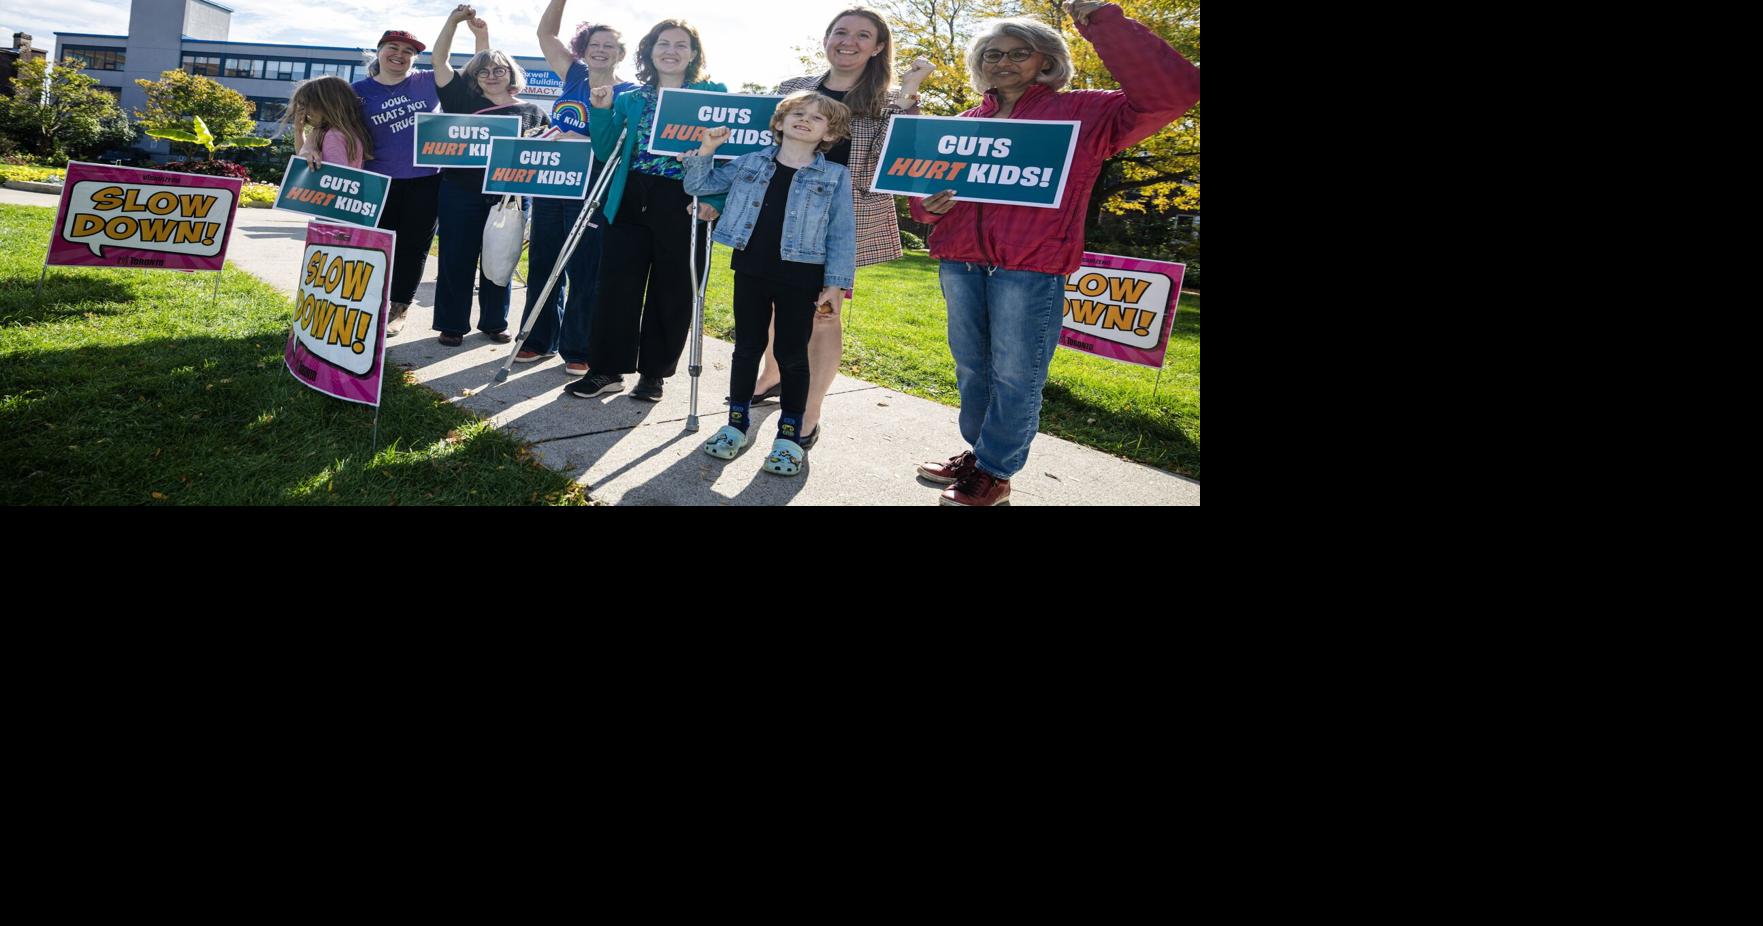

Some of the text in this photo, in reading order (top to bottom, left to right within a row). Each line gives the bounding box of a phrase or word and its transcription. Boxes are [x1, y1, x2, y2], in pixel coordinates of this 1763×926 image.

[521, 87, 557, 95] RMACY
[529, 78, 564, 88] Building
[407, 100, 428, 113] NOT
[697, 105, 752, 124] CUTS
[552, 112, 586, 129] BE KIND
[448, 125, 490, 139] CUTS
[660, 123, 779, 147] HUR KIDS
[421, 141, 468, 156] HURT
[937, 135, 1012, 158] CUTS
[519, 150, 561, 166] CUTS
[491, 167, 583, 187] HURT KIDS!
[887, 157, 1053, 188] HURT KIDS!
[320, 174, 361, 195] CUTS
[90, 186, 219, 219] SLOW
[286, 186, 378, 218] HURT KIDS!
[70, 213, 221, 246] DOWN!
[304, 250, 375, 302] SLOW
[1064, 272, 1152, 304] LOW
